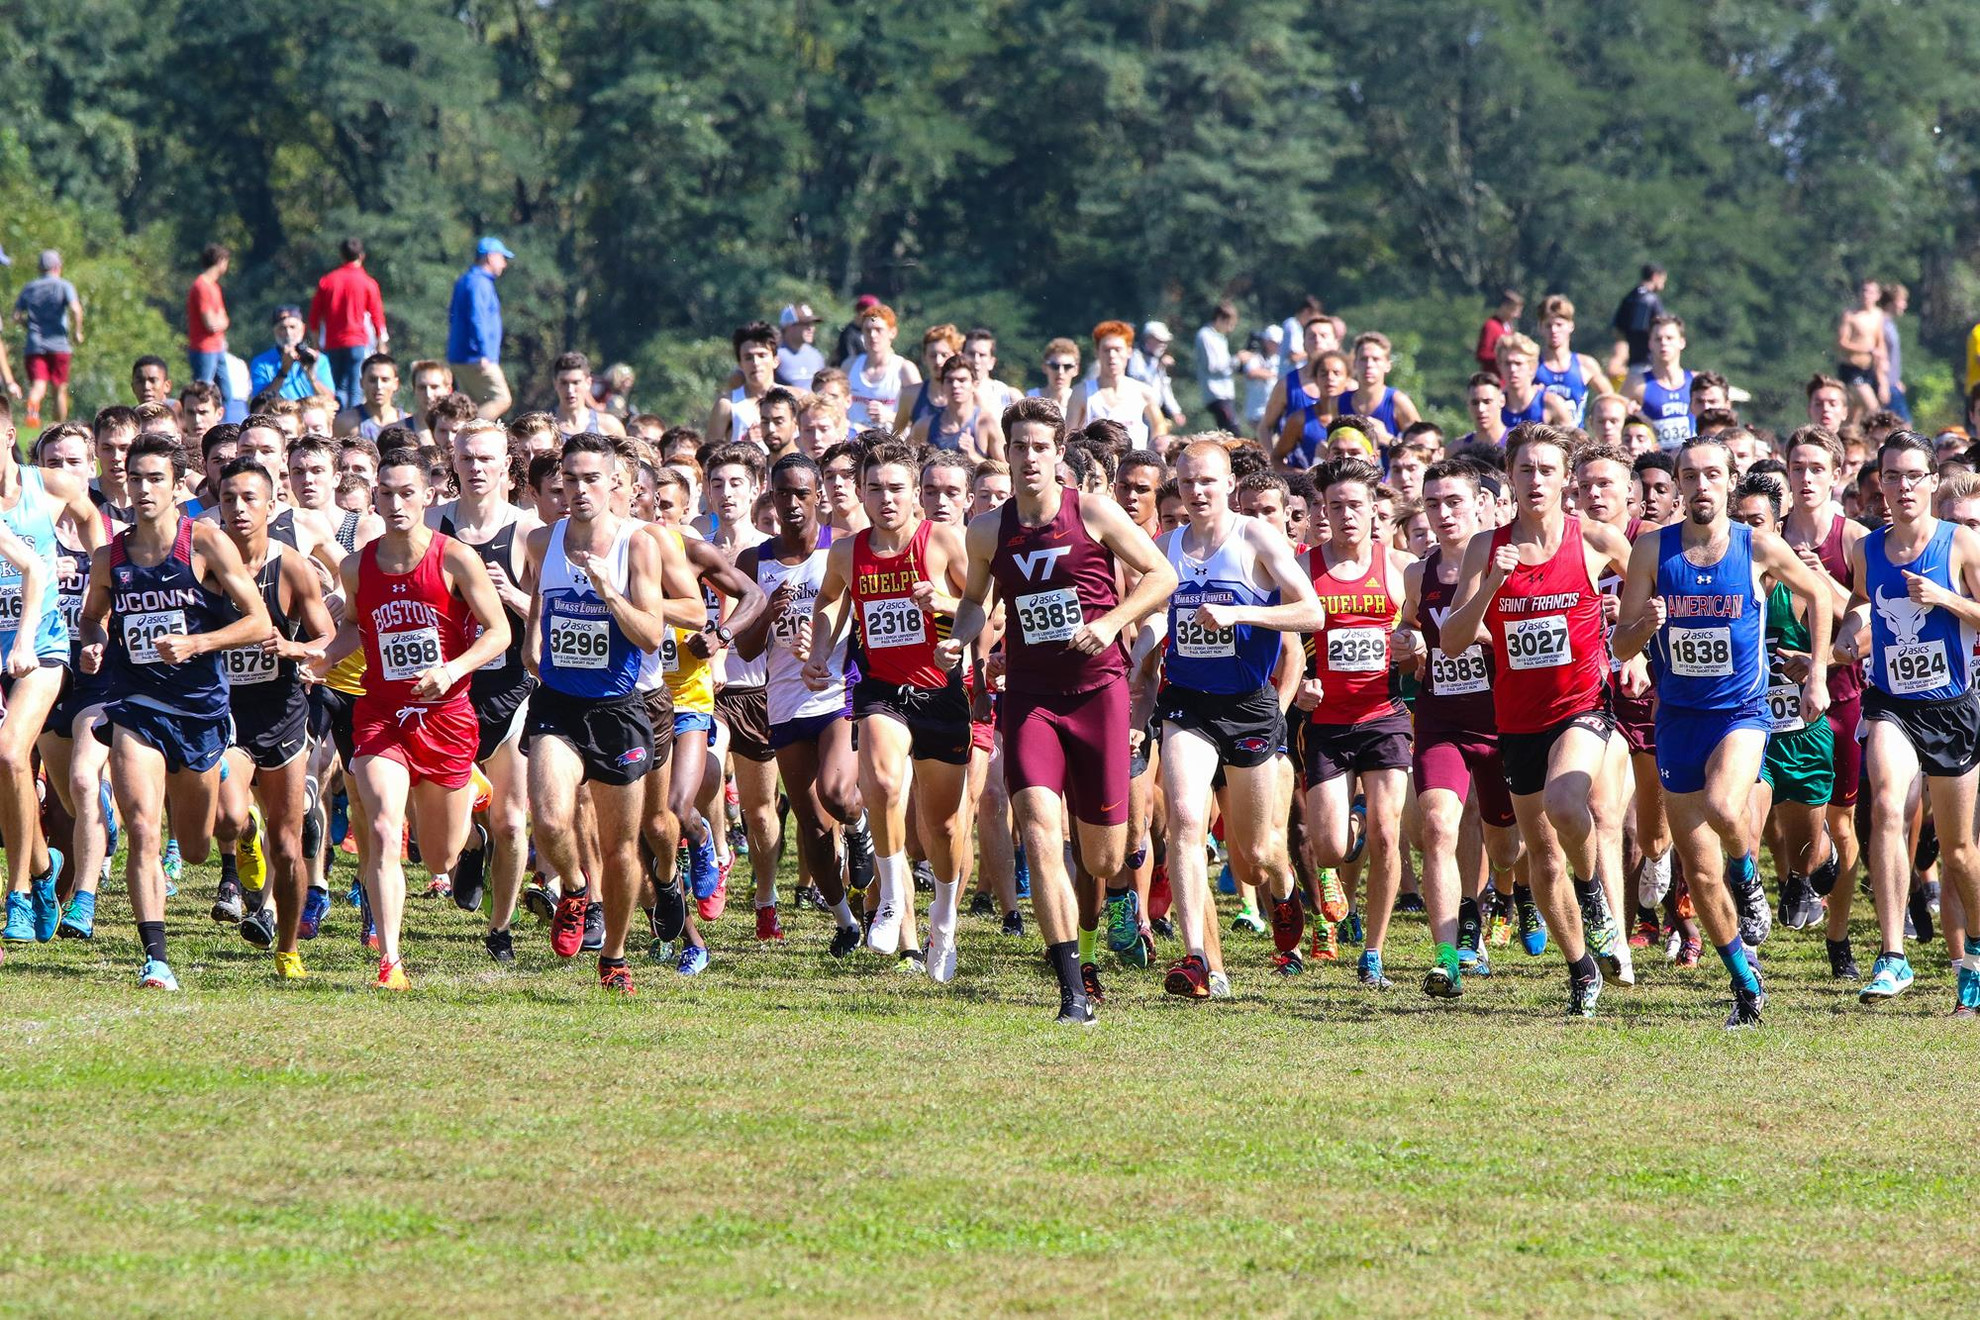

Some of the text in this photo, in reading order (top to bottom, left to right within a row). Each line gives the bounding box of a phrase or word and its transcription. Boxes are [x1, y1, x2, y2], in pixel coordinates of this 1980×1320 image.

[1012, 544, 1073, 581] VT
[859, 570, 919, 595] GUELPH
[115, 588, 195, 613] UCONN
[884, 601, 906, 610] asics
[1040, 593, 1061, 603] asics
[1318, 594, 1386, 614] GUELPH
[1499, 592, 1580, 612] SAINT FRANCIS
[1668, 594, 1744, 619] AMERICAN
[147, 615, 169, 624] asics
[372, 600, 440, 633] BOSTON
[792, 606, 811, 615] asics
[868, 608, 922, 636] 2318
[1020, 600, 1081, 632] 3385
[401, 633, 422, 642] asics
[571, 622, 592, 631] asics
[1351, 631, 1371, 639] asics
[1528, 621, 1550, 631] asics
[1691, 631, 1713, 640] asics
[383, 639, 438, 667] 1898
[551, 629, 609, 656] 3296
[1329, 639, 1385, 661] 2329
[1508, 628, 1568, 657] 3027
[1672, 640, 1729, 664] 1838
[1908, 646, 1929, 655] asics
[222, 649, 275, 674] 1878
[1434, 656, 1486, 683] 3383
[1890, 652, 1946, 681] 1924
